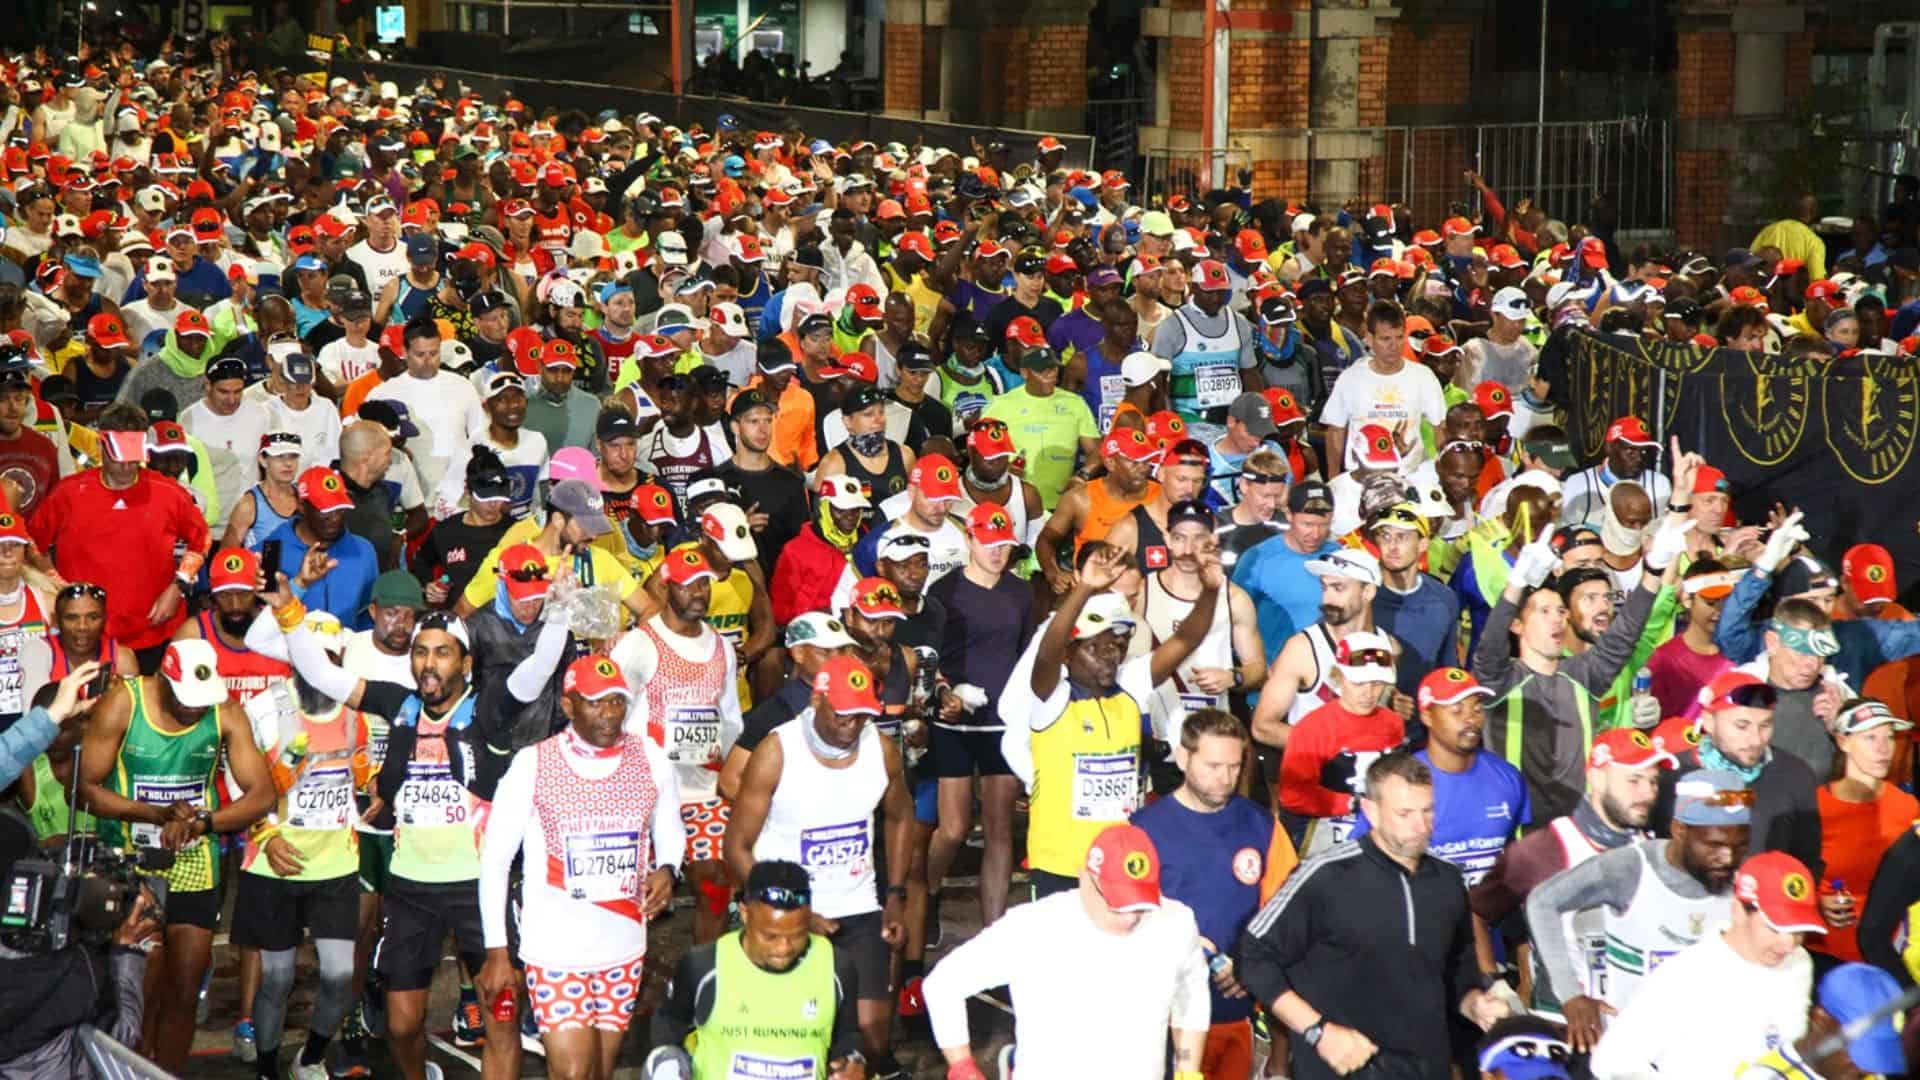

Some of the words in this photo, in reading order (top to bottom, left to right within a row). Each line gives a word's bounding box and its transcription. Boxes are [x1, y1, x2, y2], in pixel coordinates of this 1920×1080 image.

[404, 784, 461, 803] F34843
[446, 804, 467, 824] 50
[572, 853, 636, 876] D27844
[619, 874, 636, 894] 40
[720, 1025, 748, 1038] JUST
[753, 1026, 807, 1038] RUNNING
